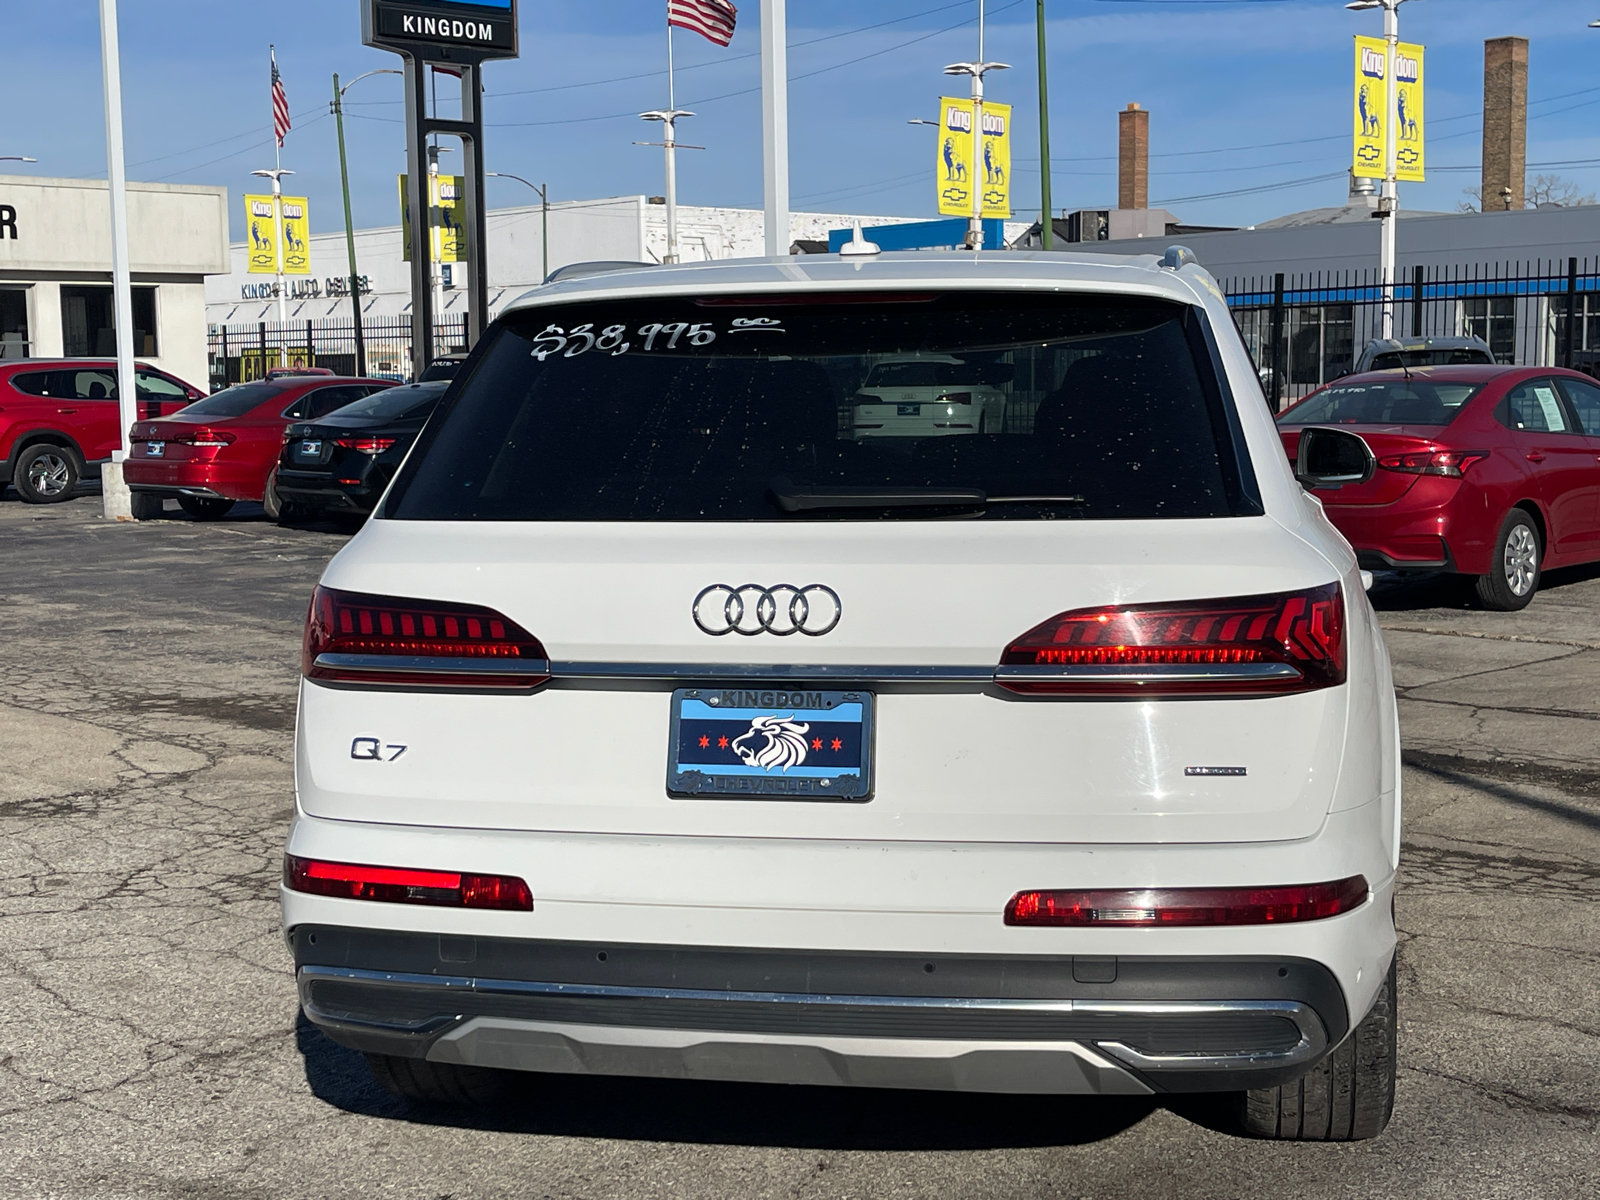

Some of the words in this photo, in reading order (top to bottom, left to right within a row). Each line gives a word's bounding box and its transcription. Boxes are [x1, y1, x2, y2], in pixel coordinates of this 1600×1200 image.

[403, 15, 493, 40] KINGDOM
[1361, 47, 1385, 80] King
[1396, 53, 1418, 83] dom
[946, 106, 971, 134] King
[982, 112, 1005, 136] dom
[251, 200, 272, 218] King
[283, 202, 303, 219] dom
[291, 278, 320, 299] AUTO
[530, 322, 717, 361] $38,995
[721, 690, 822, 708] KINGDOM
[351, 737, 408, 762] Q7
[713, 776, 820, 792] CHEVROLET
